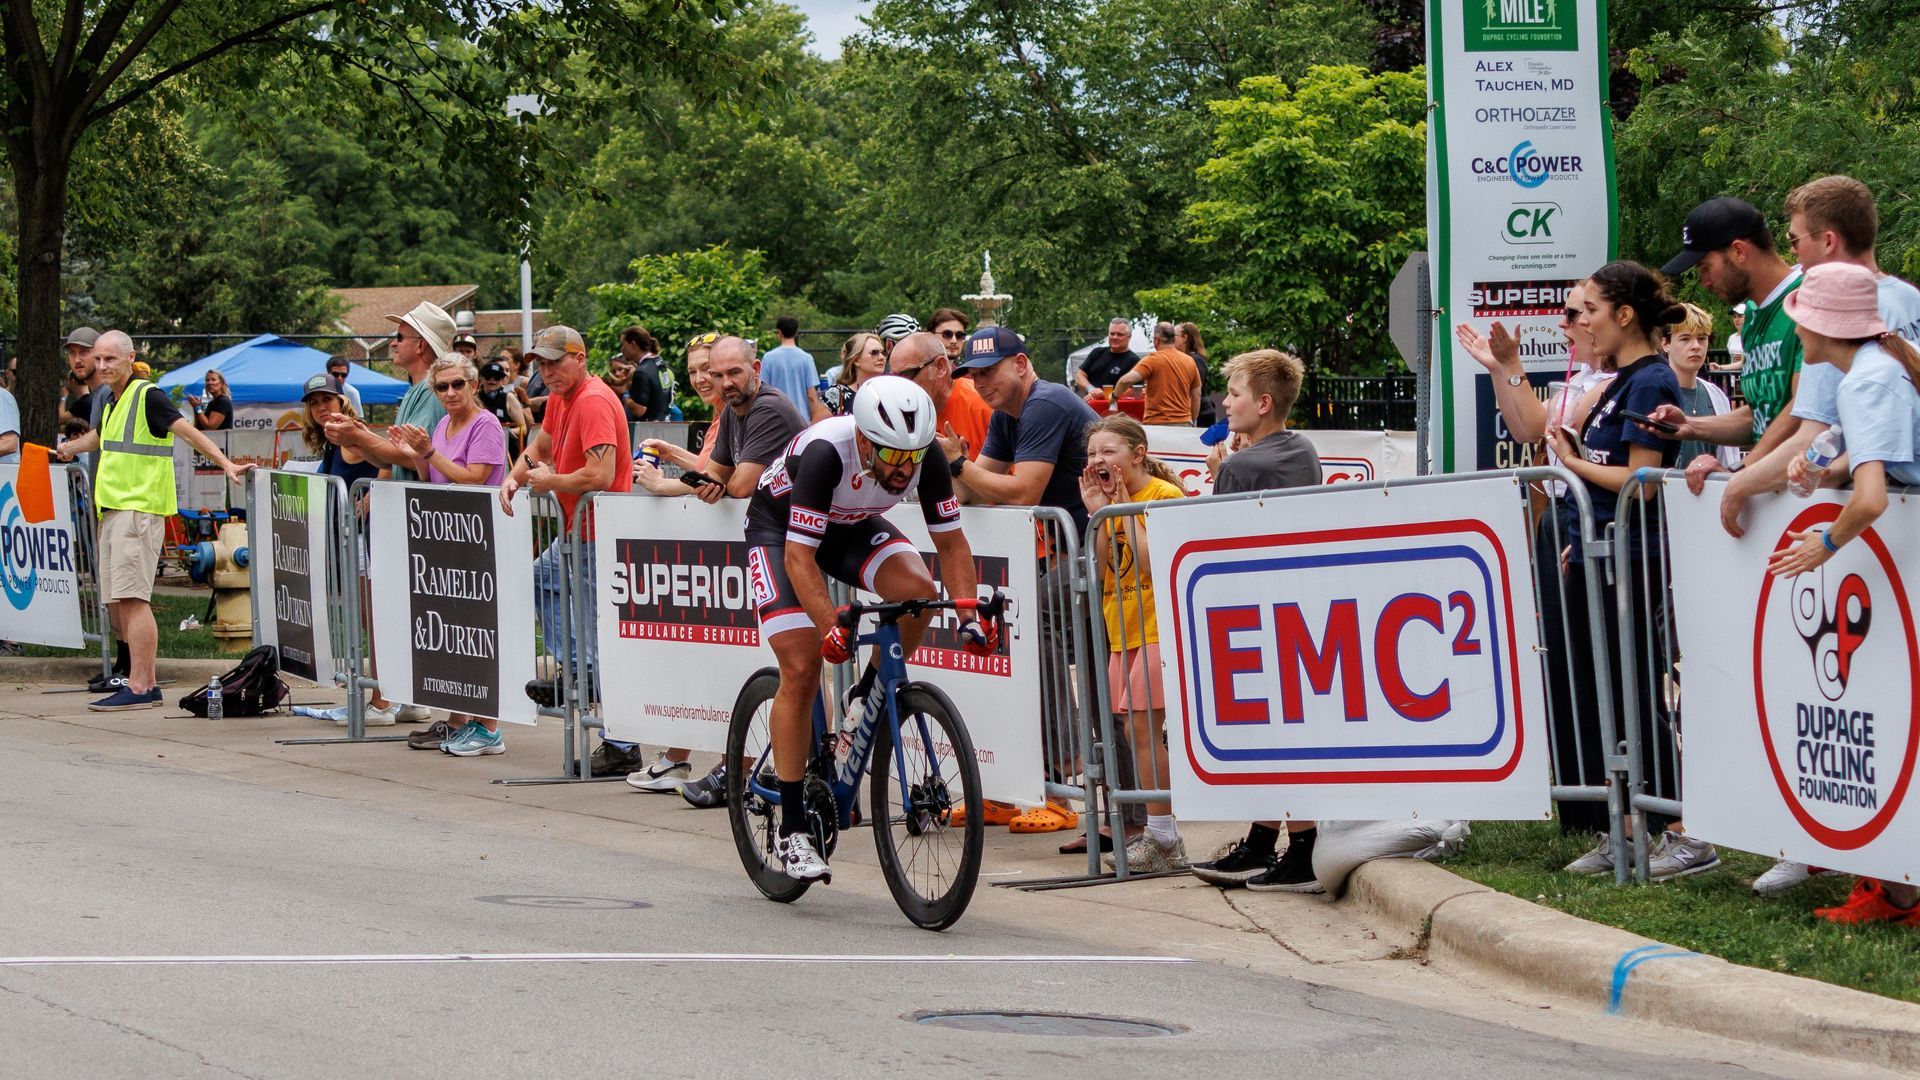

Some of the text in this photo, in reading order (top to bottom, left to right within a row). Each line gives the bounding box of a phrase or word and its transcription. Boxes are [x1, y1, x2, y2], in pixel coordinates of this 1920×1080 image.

[1500, 0, 1545, 23] MILE
[1506, 33, 1529, 41] CYCLING
[1530, 33, 1562, 41] FOUNDATION
[1551, 79, 1574, 91] MD
[1475, 107, 1576, 123] ORTHOLAZER
[1471, 156, 1583, 174] C&C POWER
[1477, 175, 1517, 183] ENGINEERED
[1507, 208, 1556, 238] CK
[1511, 262, 1557, 270] ckrunning.com
[1475, 309, 1539, 317] AMBULANCE
[409, 497, 488, 551] STORINO,
[1, 525, 74, 572] POWER
[273, 532, 310, 577] RAMELLO
[35, 577, 70, 594] PRODUCTS
[412, 553, 494, 601] RAMELLO
[621, 623, 758, 645] AMBULANCE SERVICE
[953, 653, 1008, 674] SERVICE
[422, 677, 489, 700] ATTORNEYS AT LAW
[842, 675, 886, 786] VENTUM
[1796, 702, 1875, 748] DUPAGE
[1797, 739, 1876, 784] CYCLING
[1799, 776, 1877, 810] FOUNDATION
